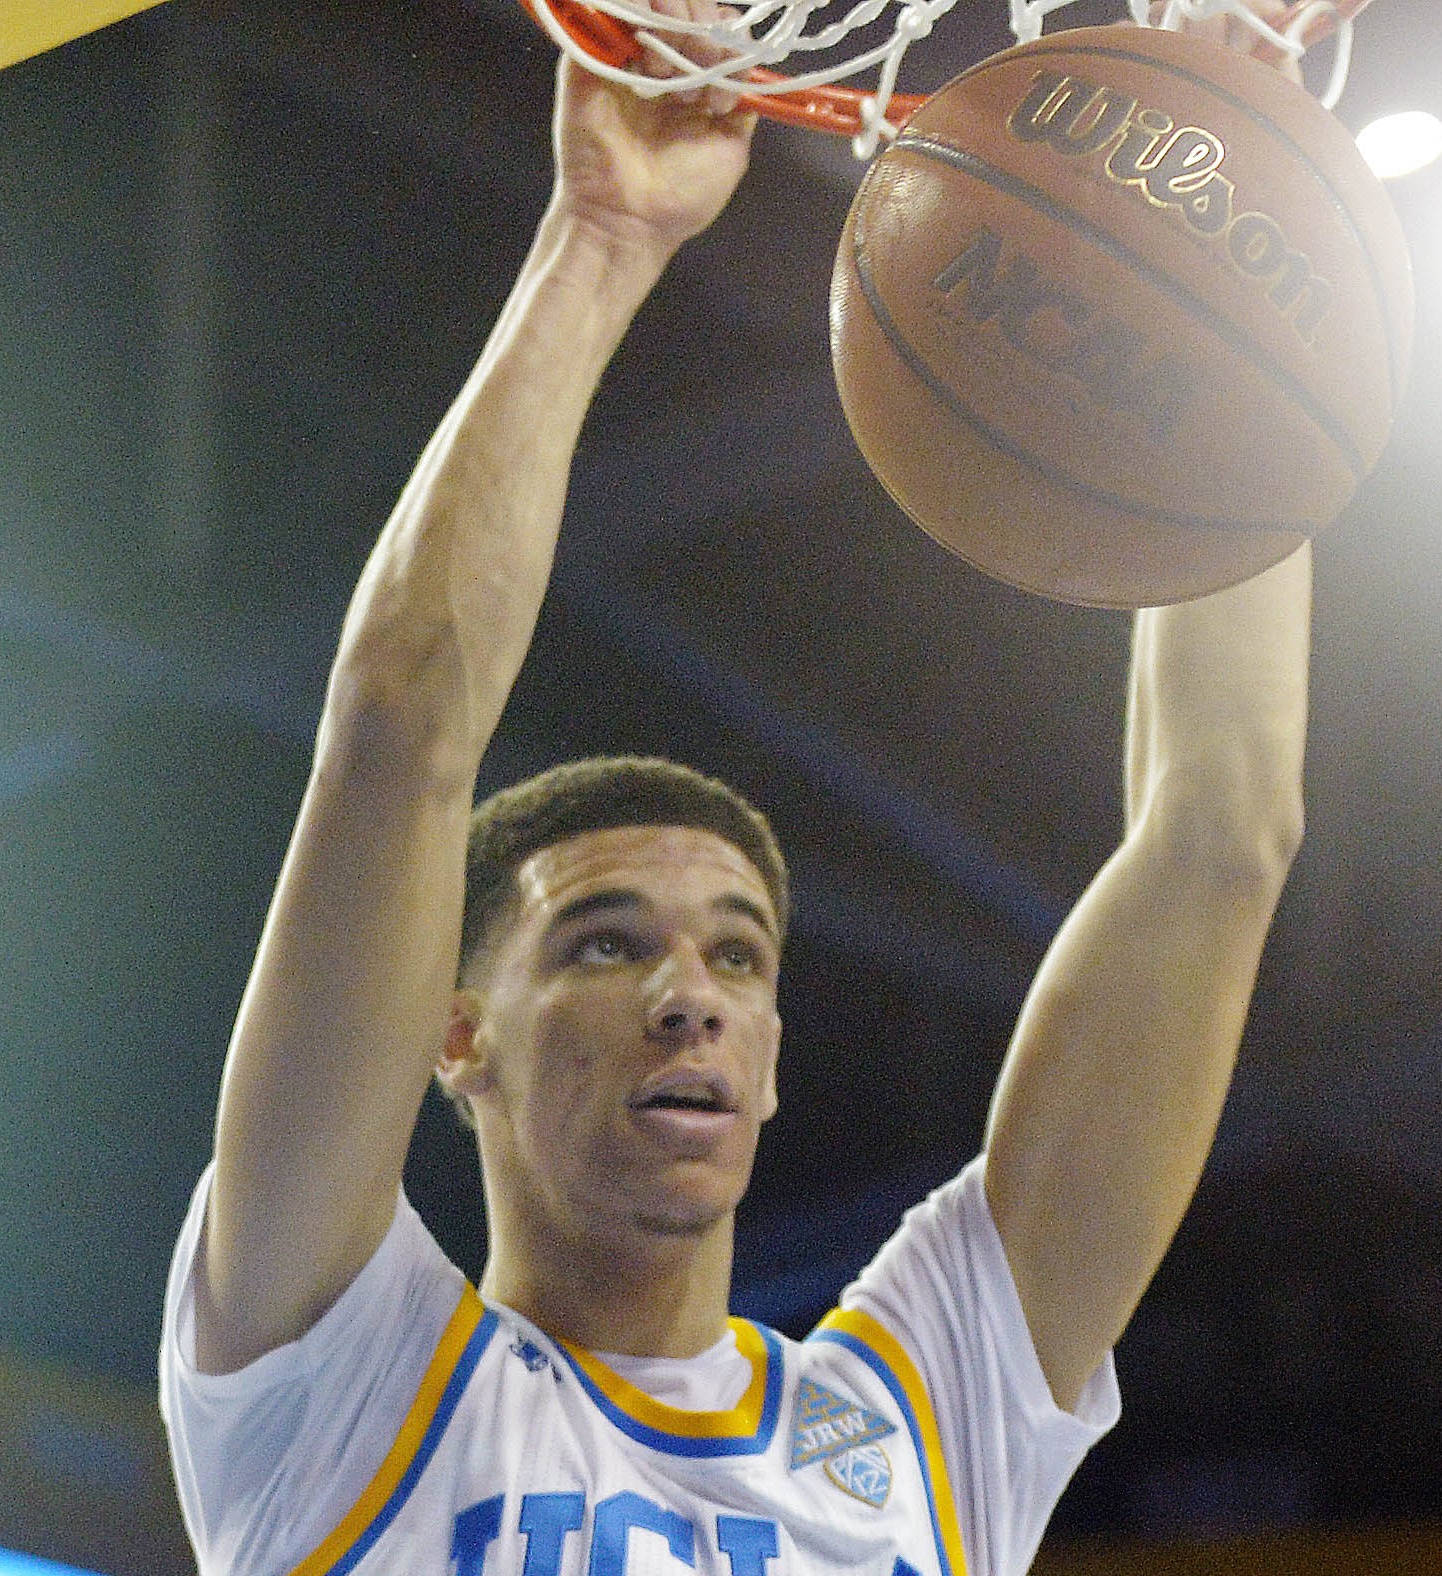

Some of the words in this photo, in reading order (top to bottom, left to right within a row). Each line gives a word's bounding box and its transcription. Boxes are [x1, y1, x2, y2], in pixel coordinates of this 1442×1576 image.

[1004, 70, 1335, 345] Wilson
[932, 226, 1200, 440] NCAA
[801, 1410, 866, 1449] JRW
